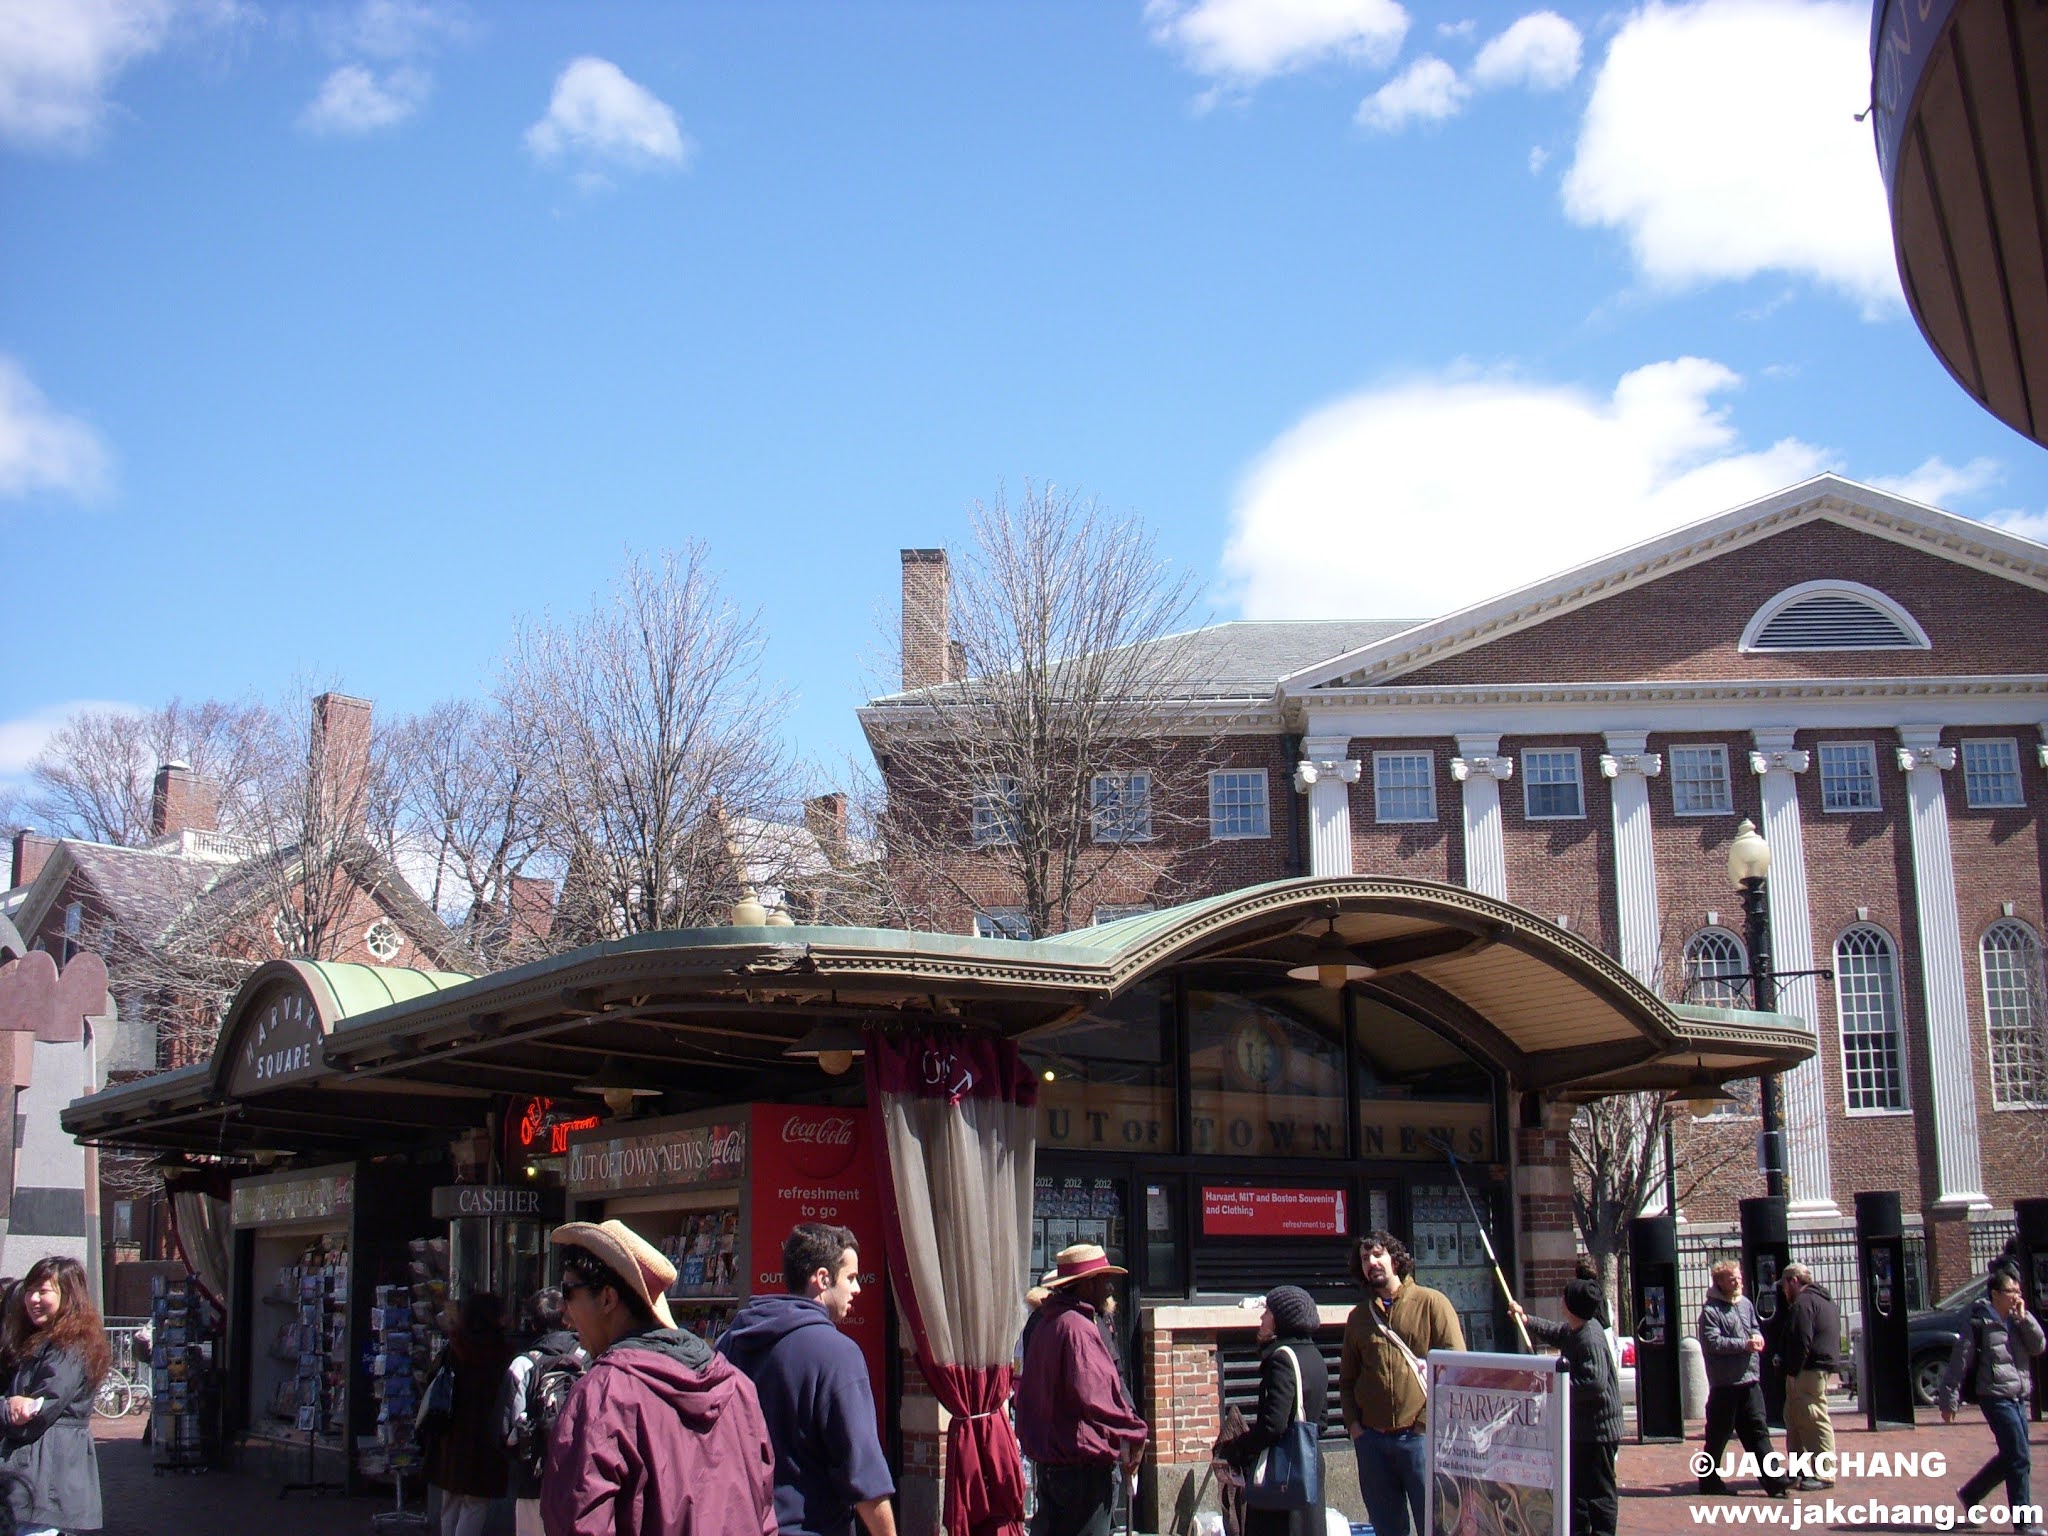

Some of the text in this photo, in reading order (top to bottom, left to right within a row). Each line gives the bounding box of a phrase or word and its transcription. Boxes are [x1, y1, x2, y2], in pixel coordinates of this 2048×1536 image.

[257, 1043, 311, 1078] SQUARE
[781, 1115, 855, 1145] Coca-Cola
[1046, 1108, 1109, 1142] UT
[1192, 1116, 1333, 1151] TOWN
[1363, 1124, 1484, 1153] NEWS
[571, 1141, 704, 1182] OUT OF TOWN NEWS
[1035, 1176, 1054, 1188] 2012
[1064, 1178, 1083, 1188] 2012
[1094, 1179, 1112, 1189] 2012
[459, 1189, 541, 1213] CASHIER
[777, 1186, 860, 1201] refreshment
[1205, 1191, 1335, 1204] Harvard, MIT and Boston Souvenirs
[801, 1204, 838, 1219] to go
[1205, 1205, 1254, 1217] and Clothing
[1282, 1220, 1335, 1230] refreshment to go
[1449, 1391, 1541, 1427] HARVARD
